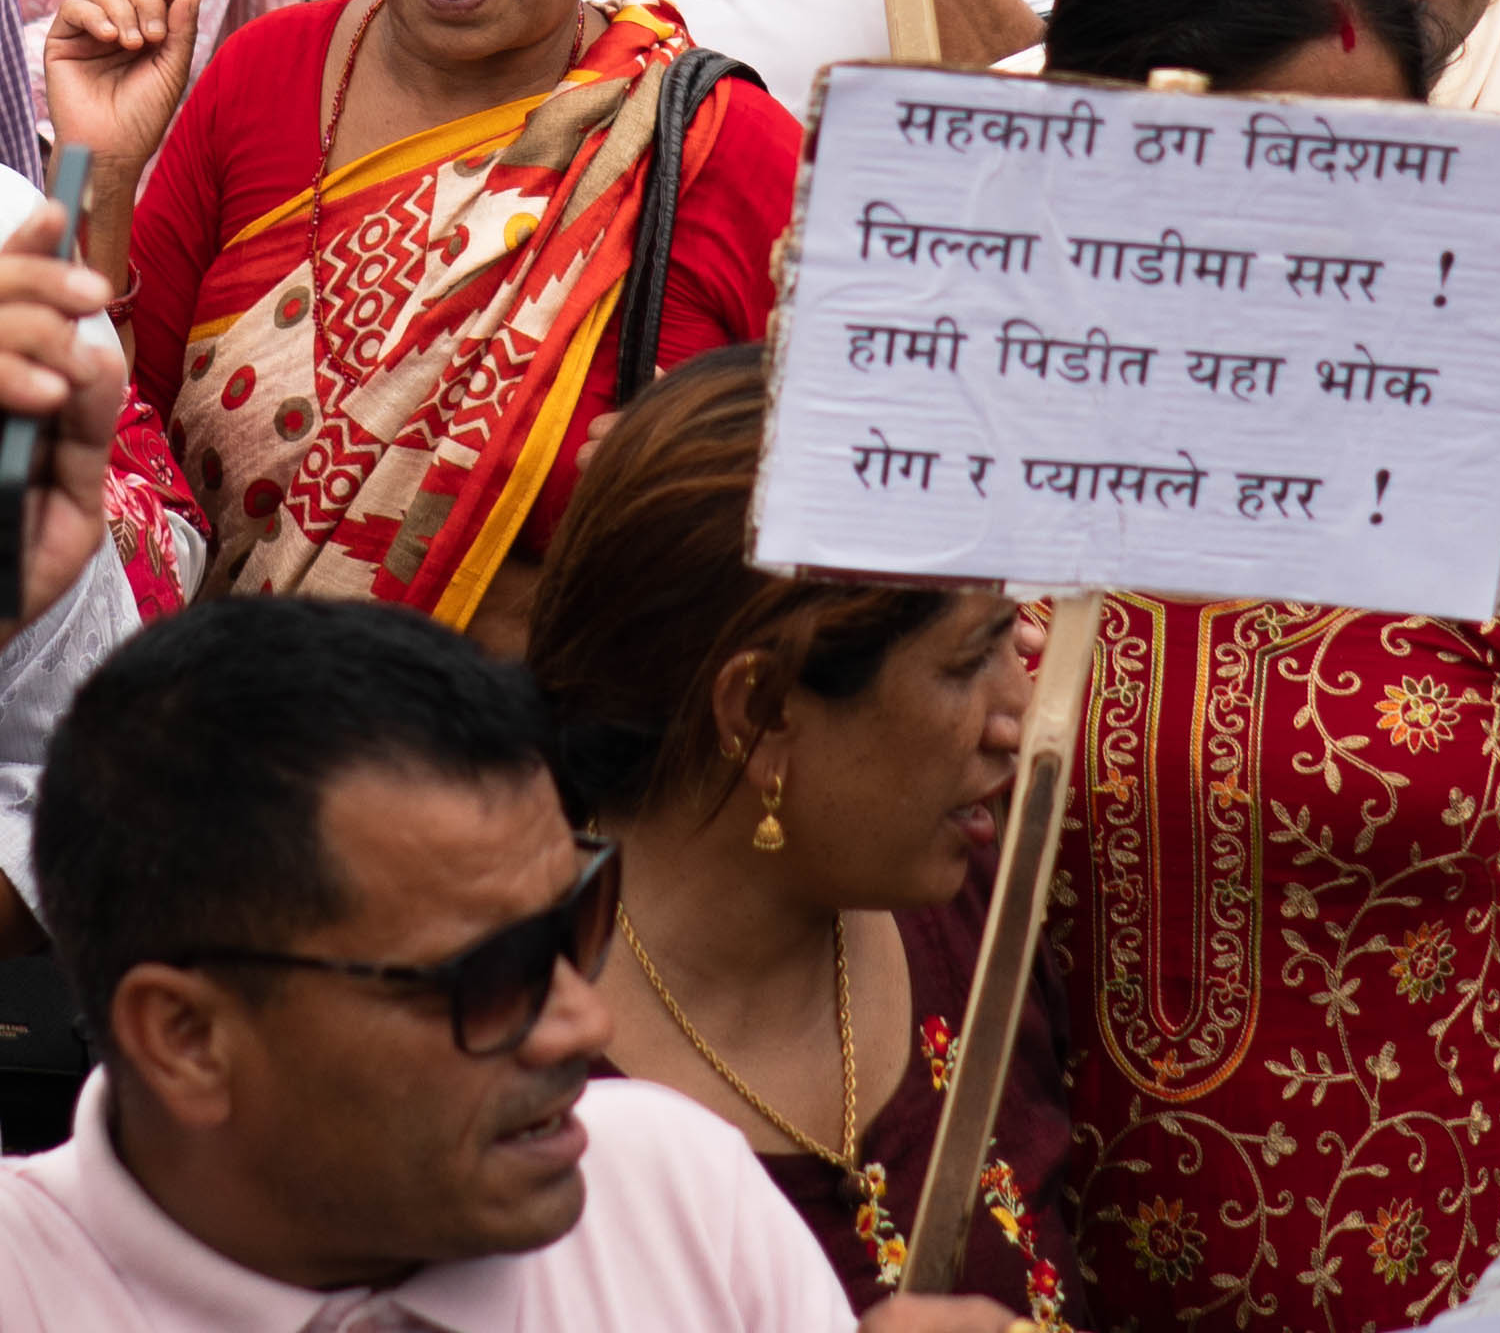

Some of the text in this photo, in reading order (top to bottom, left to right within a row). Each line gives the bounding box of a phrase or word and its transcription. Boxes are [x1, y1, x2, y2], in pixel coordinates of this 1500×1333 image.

[896, 99, 1459, 184] सहकारी ठग बिदेशमा
[856, 201, 1454, 307] चिल्ला गाडीमा सरर !
[845, 316, 1439, 405] हामी पिडीत यहा भोक
[852, 428, 1390, 525] रोग र प्यासले हरर !
